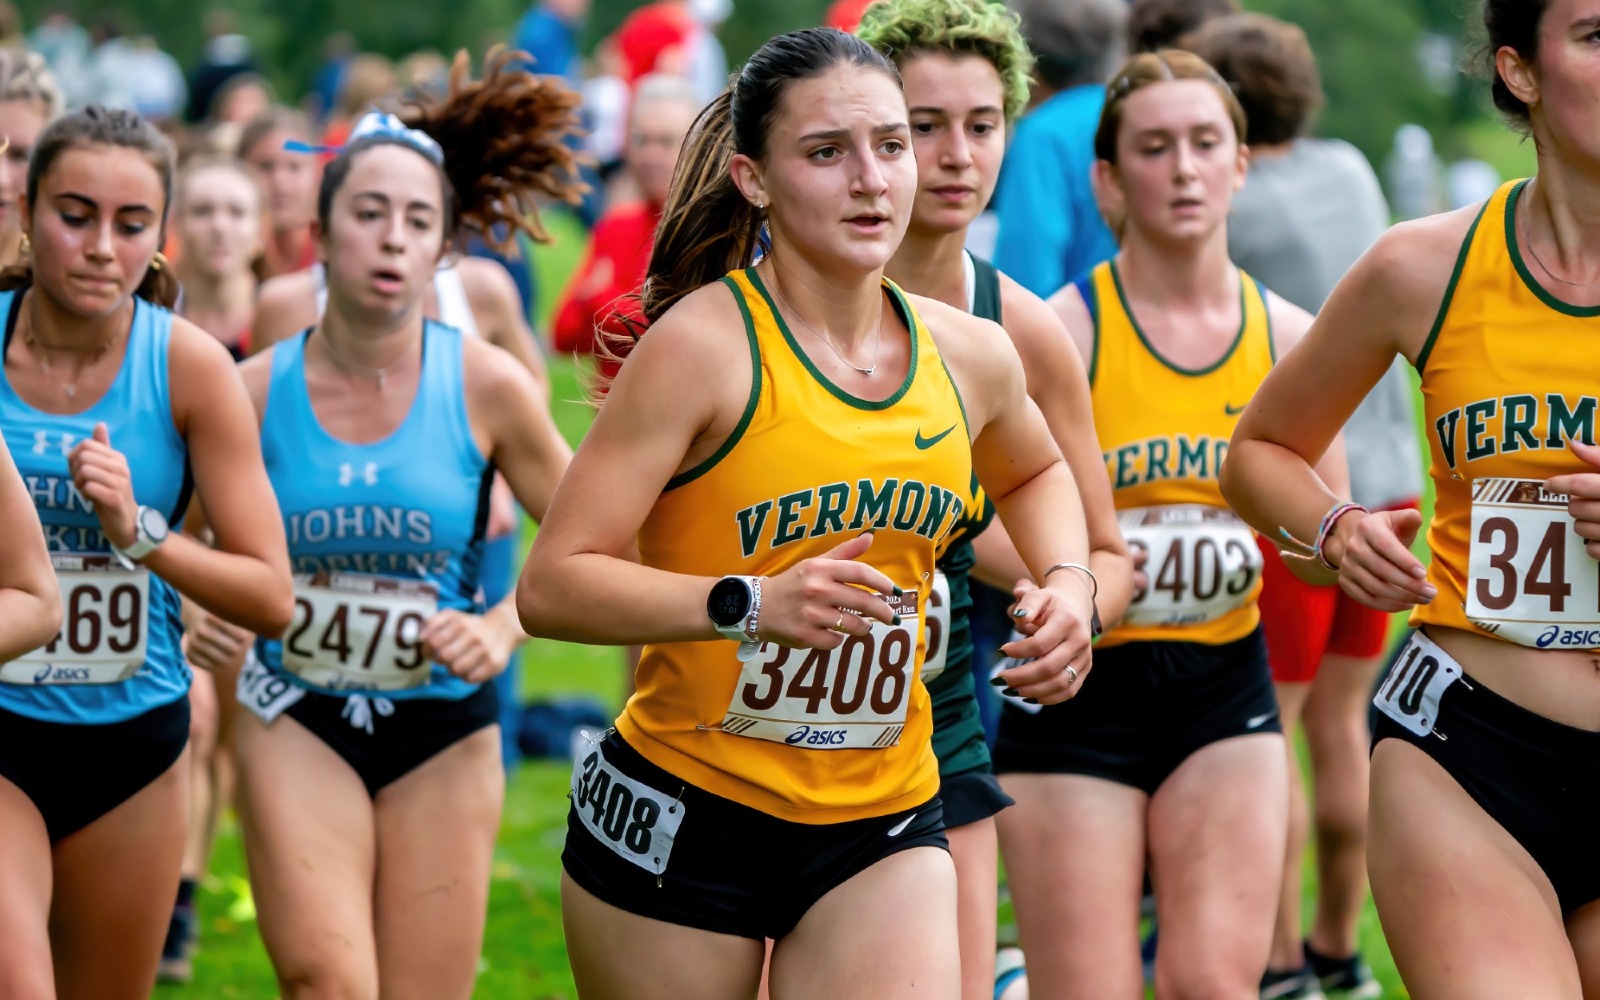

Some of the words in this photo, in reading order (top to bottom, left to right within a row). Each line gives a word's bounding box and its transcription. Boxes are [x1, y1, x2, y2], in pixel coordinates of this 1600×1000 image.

[1103, 434, 1230, 490] ERM
[291, 505, 432, 543] JOHNS
[735, 478, 963, 557] VERMONT
[1476, 517, 1600, 612] 34
[46, 584, 141, 654] 69
[288, 599, 424, 669] 2479
[1560, 630, 1600, 645] asic
[742, 629, 910, 715] 3408
[1380, 639, 1439, 715] 10
[578, 751, 660, 854] 3408
